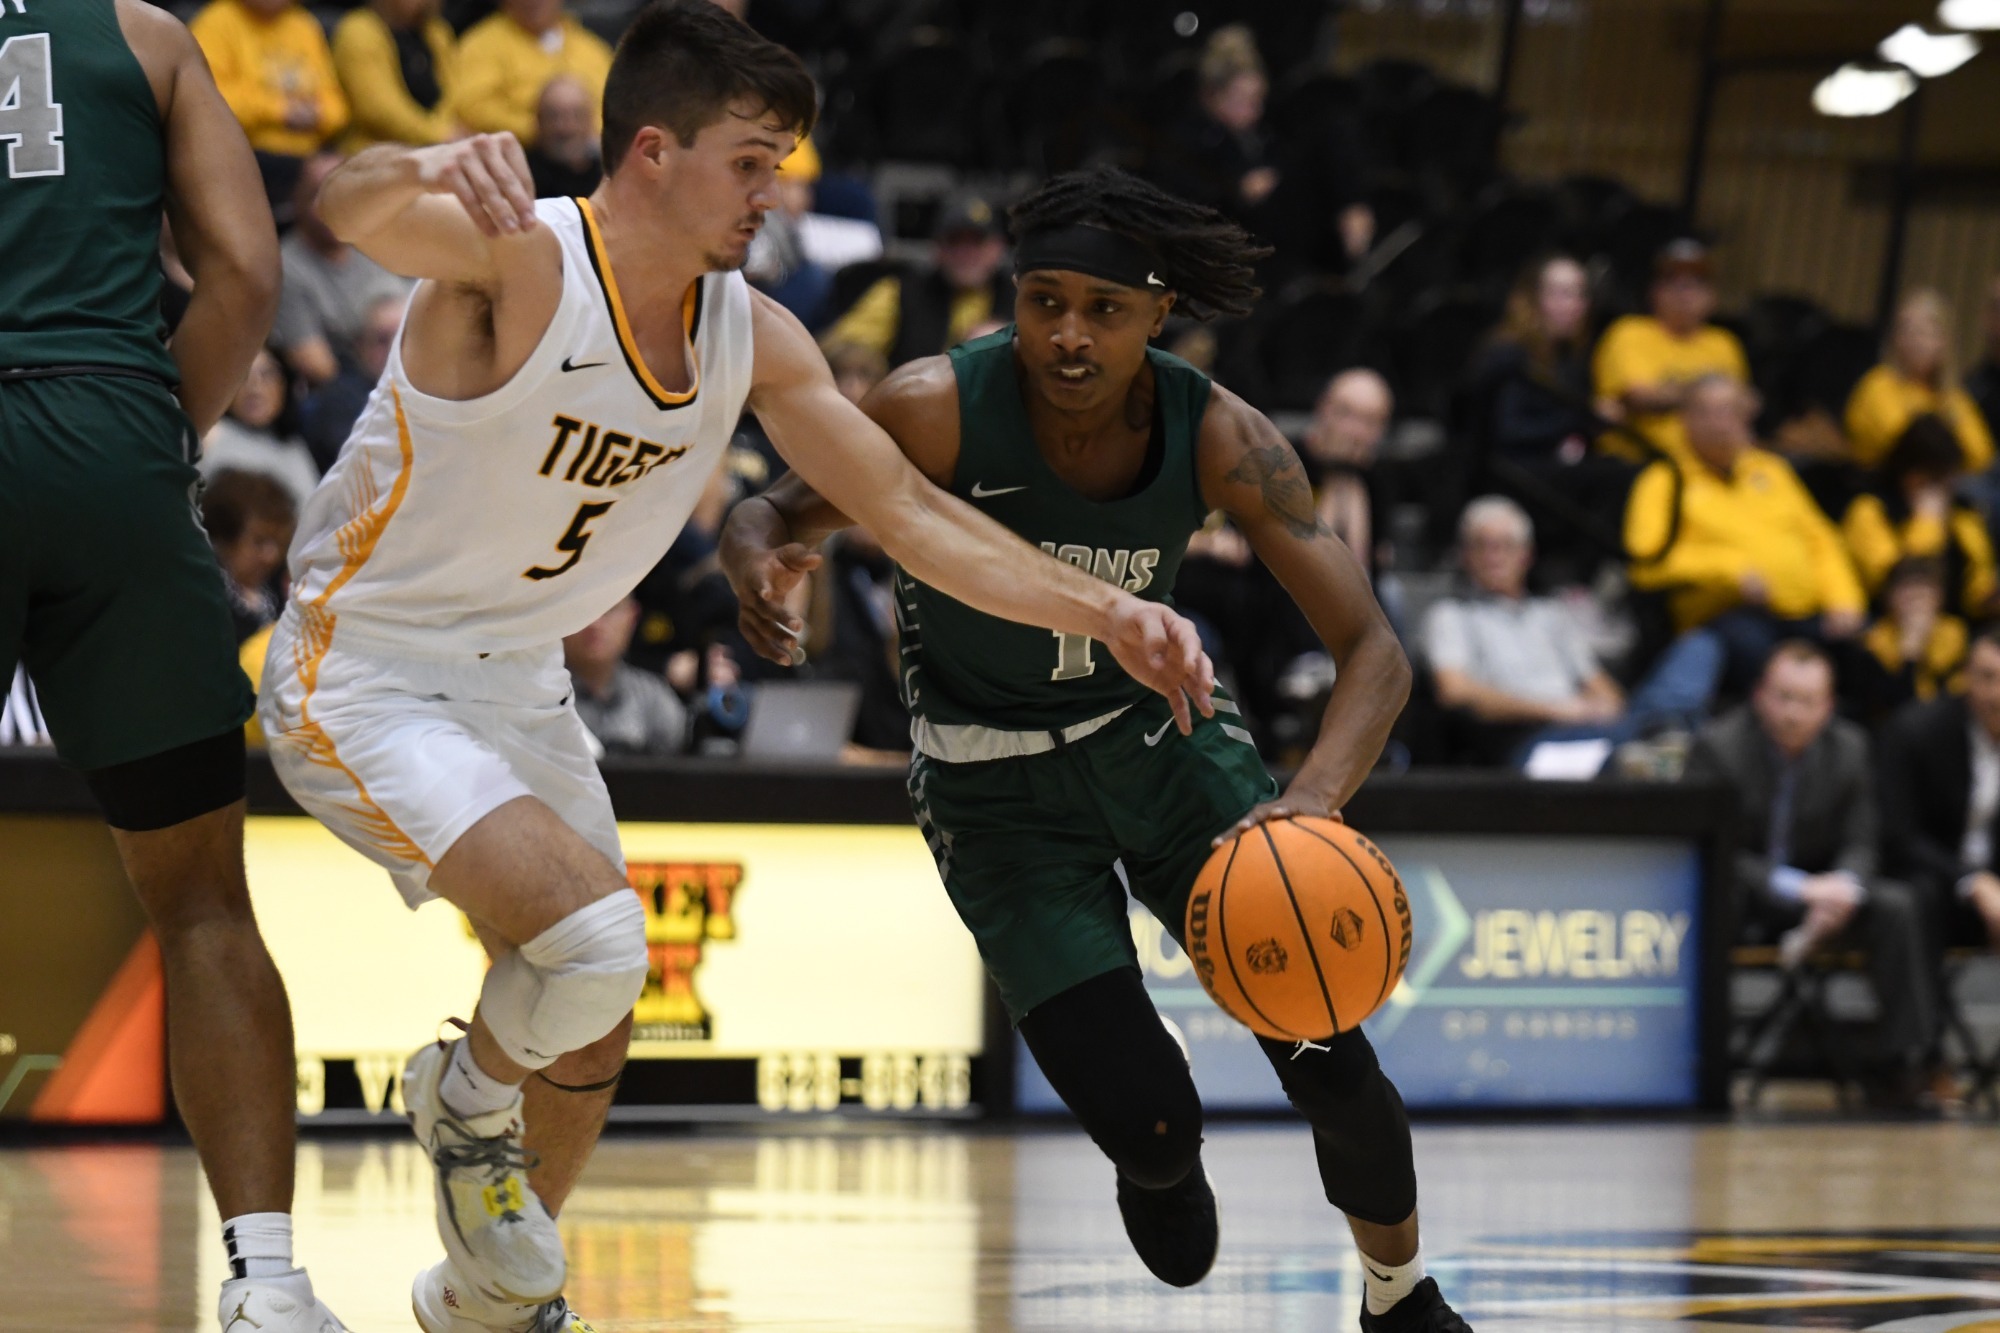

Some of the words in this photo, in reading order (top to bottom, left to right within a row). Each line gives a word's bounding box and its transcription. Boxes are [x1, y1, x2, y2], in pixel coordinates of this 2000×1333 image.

[0, 32, 65, 178] 4
[520, 499, 618, 581] 5
[1051, 629, 1096, 681] 1
[1460, 909, 1691, 979] JEWELRY
